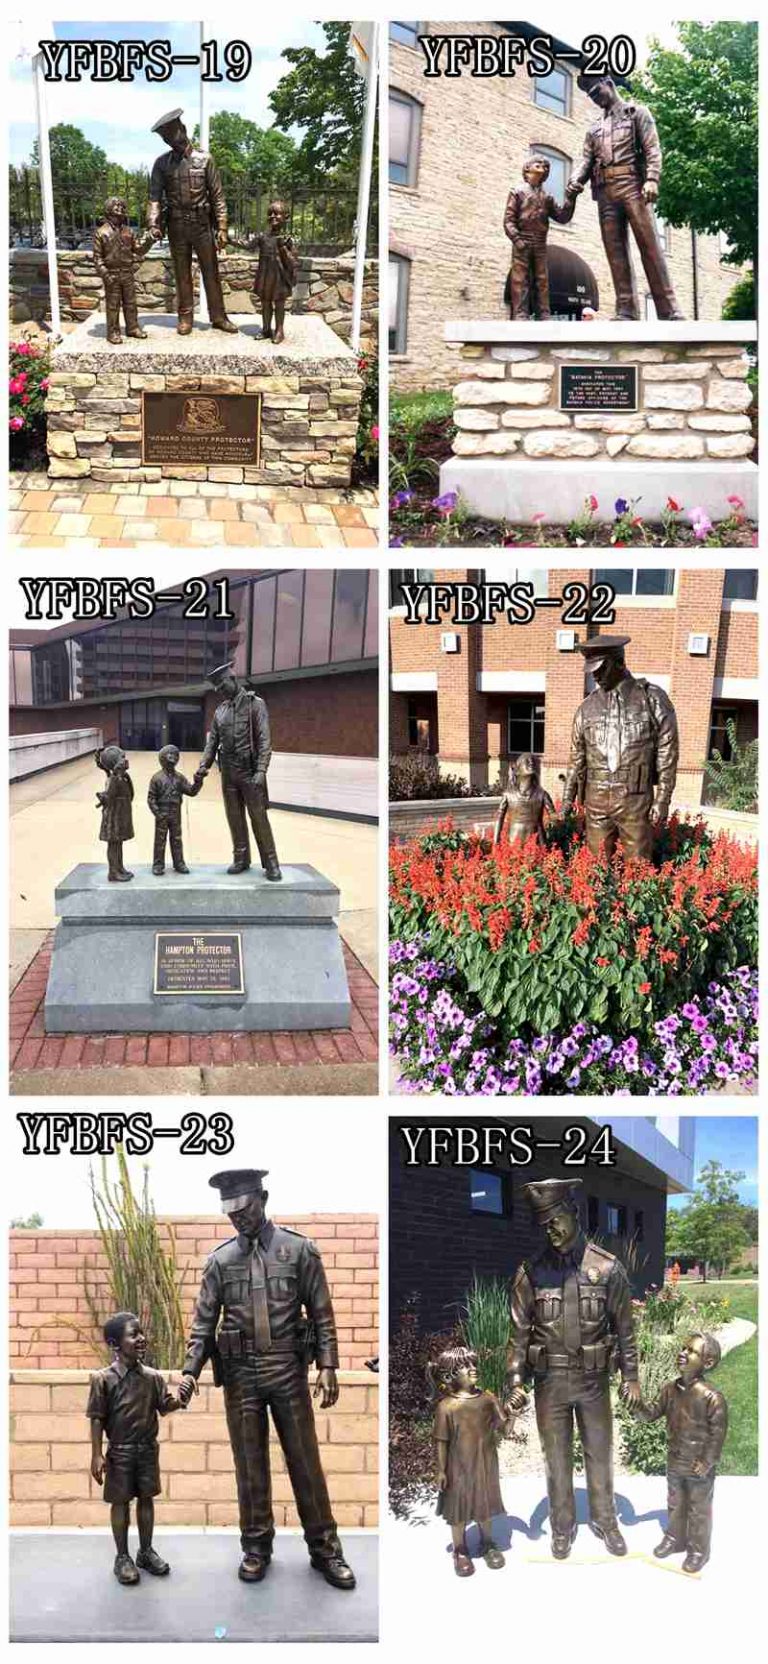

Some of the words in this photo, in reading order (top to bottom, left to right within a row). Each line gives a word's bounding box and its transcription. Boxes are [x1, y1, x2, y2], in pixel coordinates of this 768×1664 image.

[192, 937, 205, 946] THE
[165, 945, 194, 954] HAMPTON
[196, 945, 232, 954] PROTECTOR
